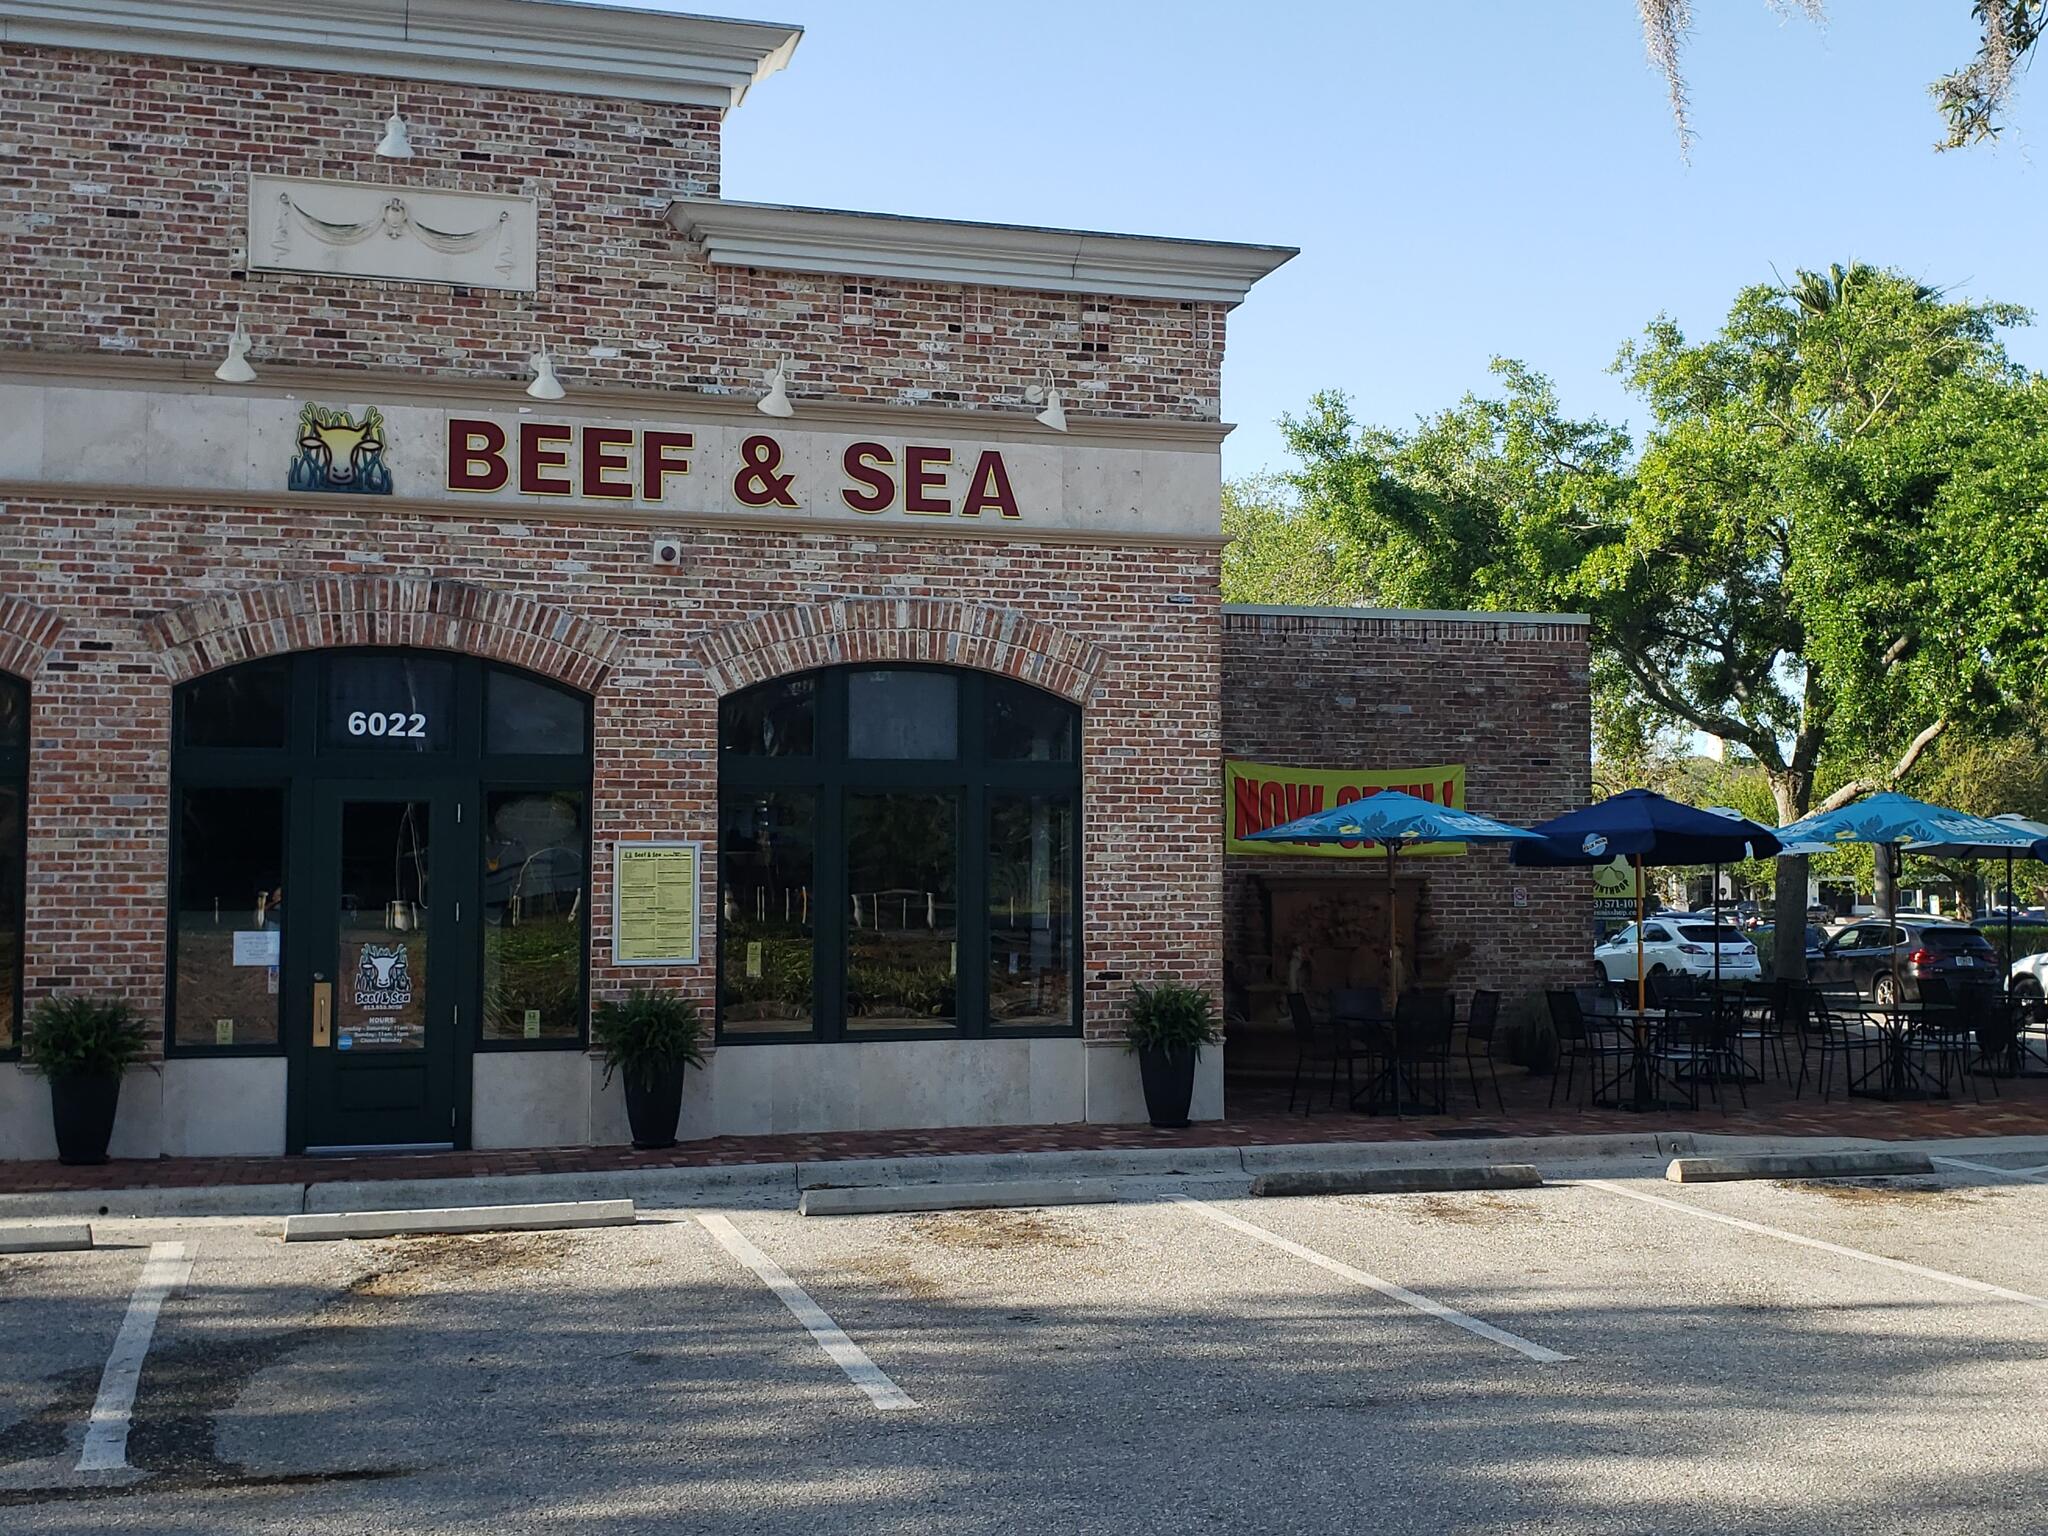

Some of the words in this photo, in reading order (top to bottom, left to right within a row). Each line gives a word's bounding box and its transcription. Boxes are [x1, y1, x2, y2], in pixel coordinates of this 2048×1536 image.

[446, 418, 696, 502] BEEF
[731, 433, 802, 509] &
[840, 440, 1023, 520] SEA
[348, 711, 426, 737] 6022
[355, 991, 381, 1005] Beef
[391, 991, 411, 1004] Sea
